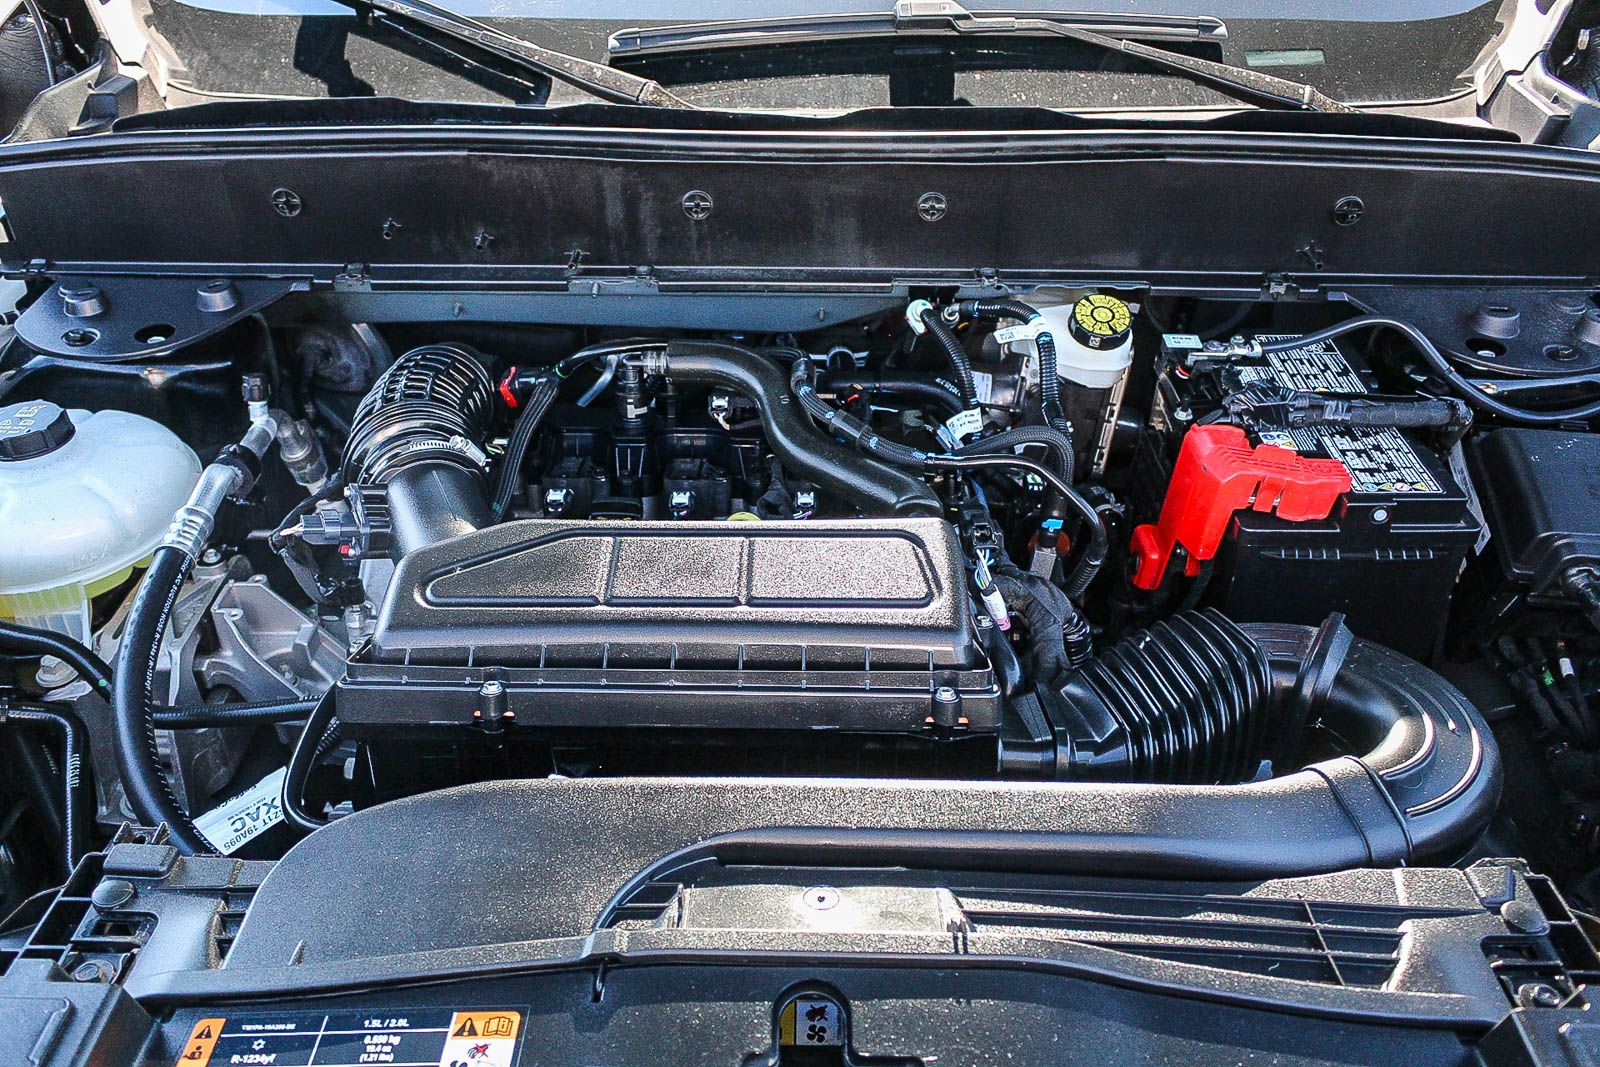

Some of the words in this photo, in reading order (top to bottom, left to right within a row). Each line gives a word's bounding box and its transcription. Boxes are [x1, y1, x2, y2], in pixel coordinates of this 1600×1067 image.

[163, 584, 178, 614] SUCTION
[156, 612, 168, 633] HOSE
[230, 796, 280, 833] XAC
[223, 824, 260, 851] 19A095
[363, 1018, 382, 1028] 1.5L
[389, 1018, 410, 1028] 2.0L
[230, 1053, 277, 1065] R-1234yf
